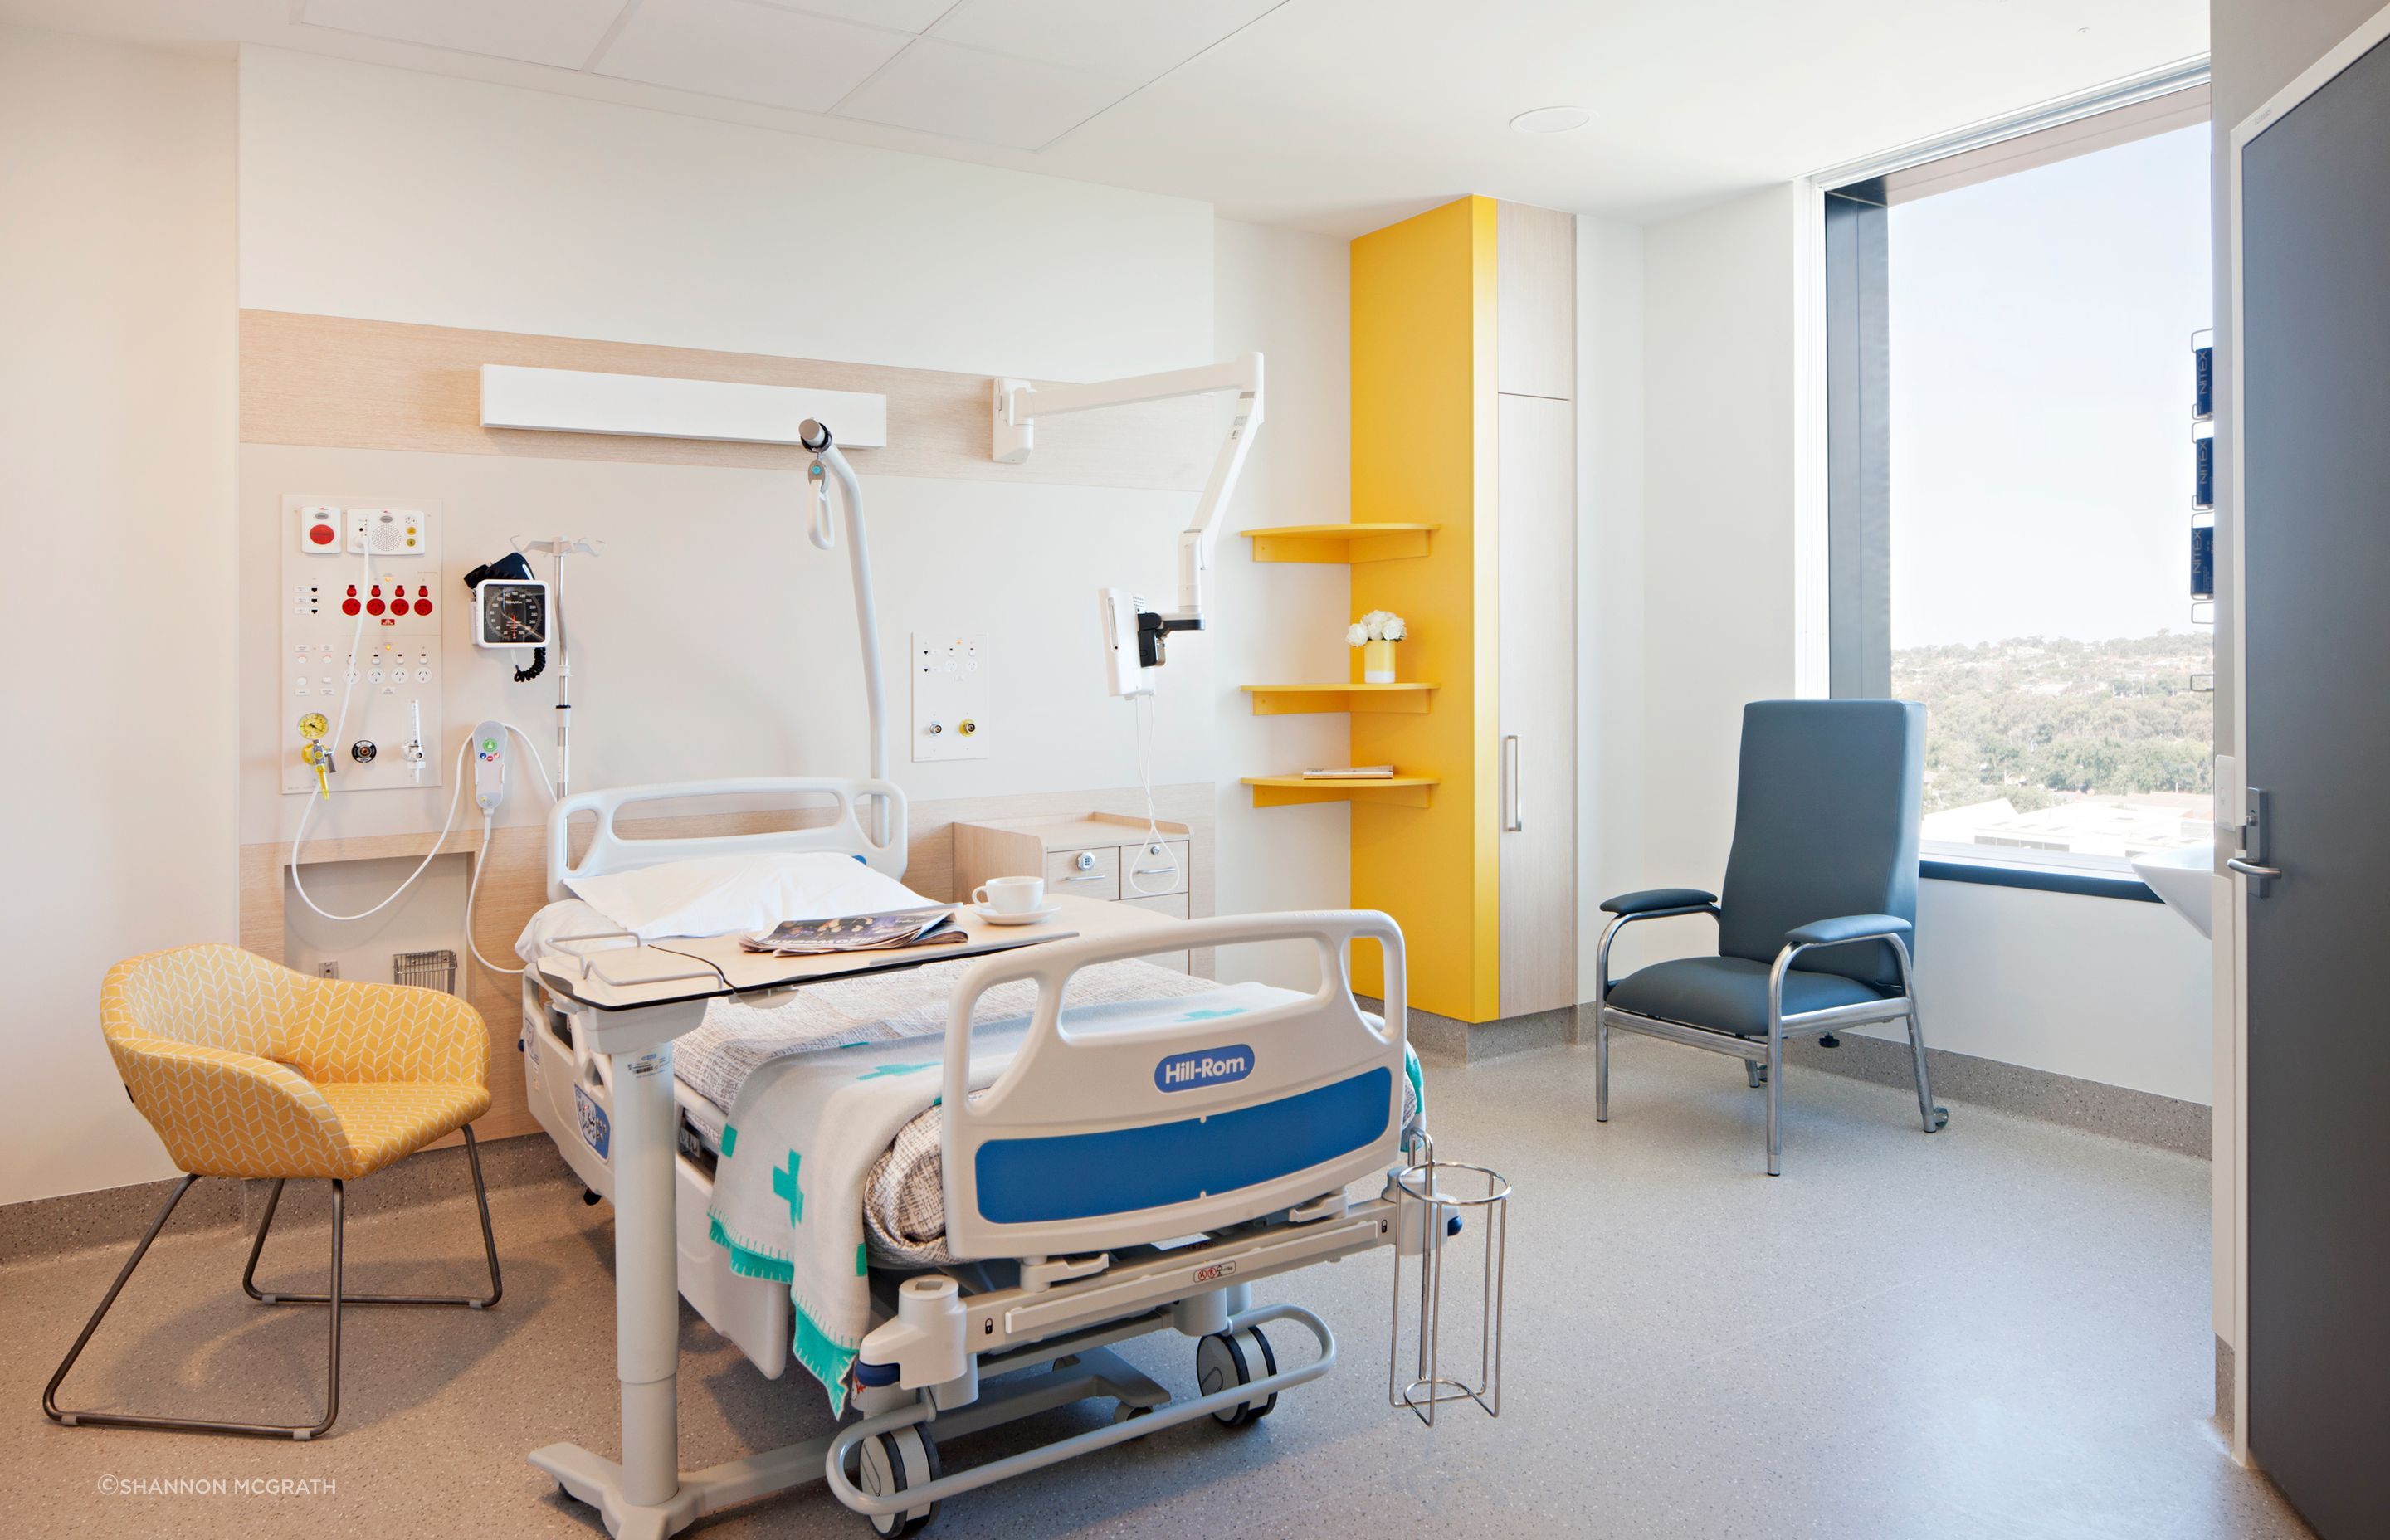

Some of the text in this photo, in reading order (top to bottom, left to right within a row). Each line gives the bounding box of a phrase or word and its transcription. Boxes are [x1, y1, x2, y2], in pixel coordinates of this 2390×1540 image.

[2198, 350, 2208, 395] NITEX
[2199, 441, 2208, 485] NITEX
[2192, 529, 2202, 574] NITEX
[1165, 1057, 1245, 1084] Hill-Rom
